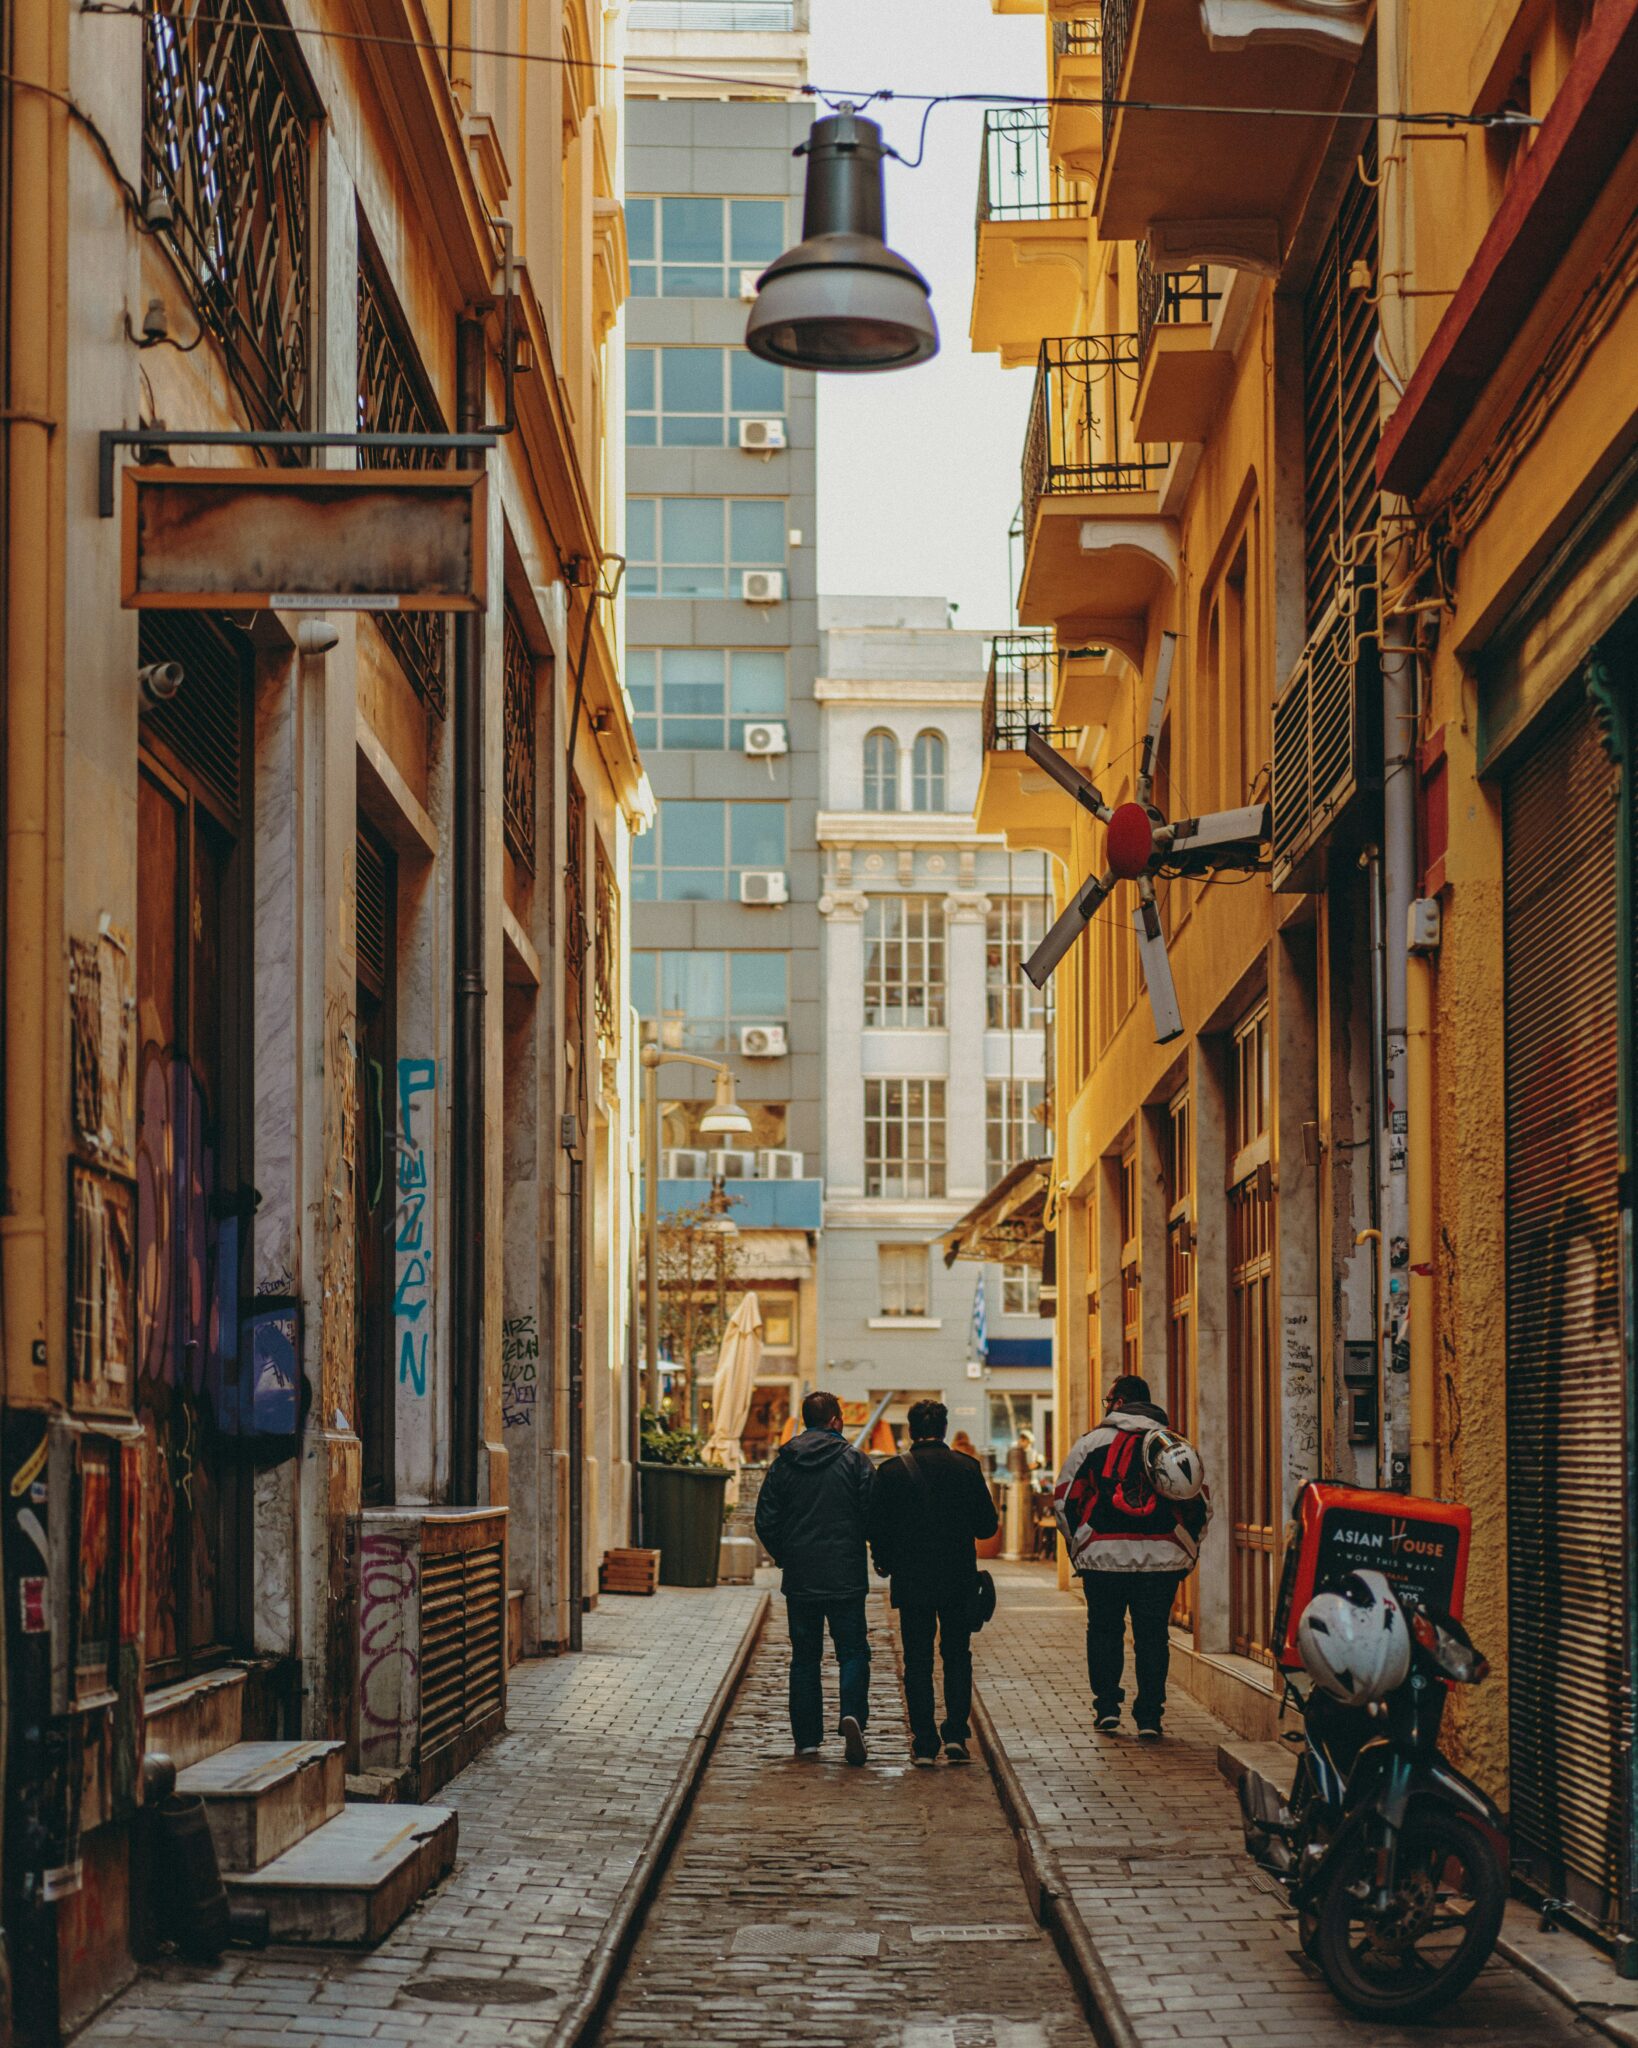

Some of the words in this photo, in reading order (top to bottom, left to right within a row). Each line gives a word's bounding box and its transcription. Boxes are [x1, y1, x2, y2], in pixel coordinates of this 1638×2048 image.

[1333, 1529, 1383, 1548] ASIAN
[1346, 1553, 1368, 1563] WOK
[1376, 1557, 1398, 1568] THIS
[1406, 1563, 1428, 1572] WAY
